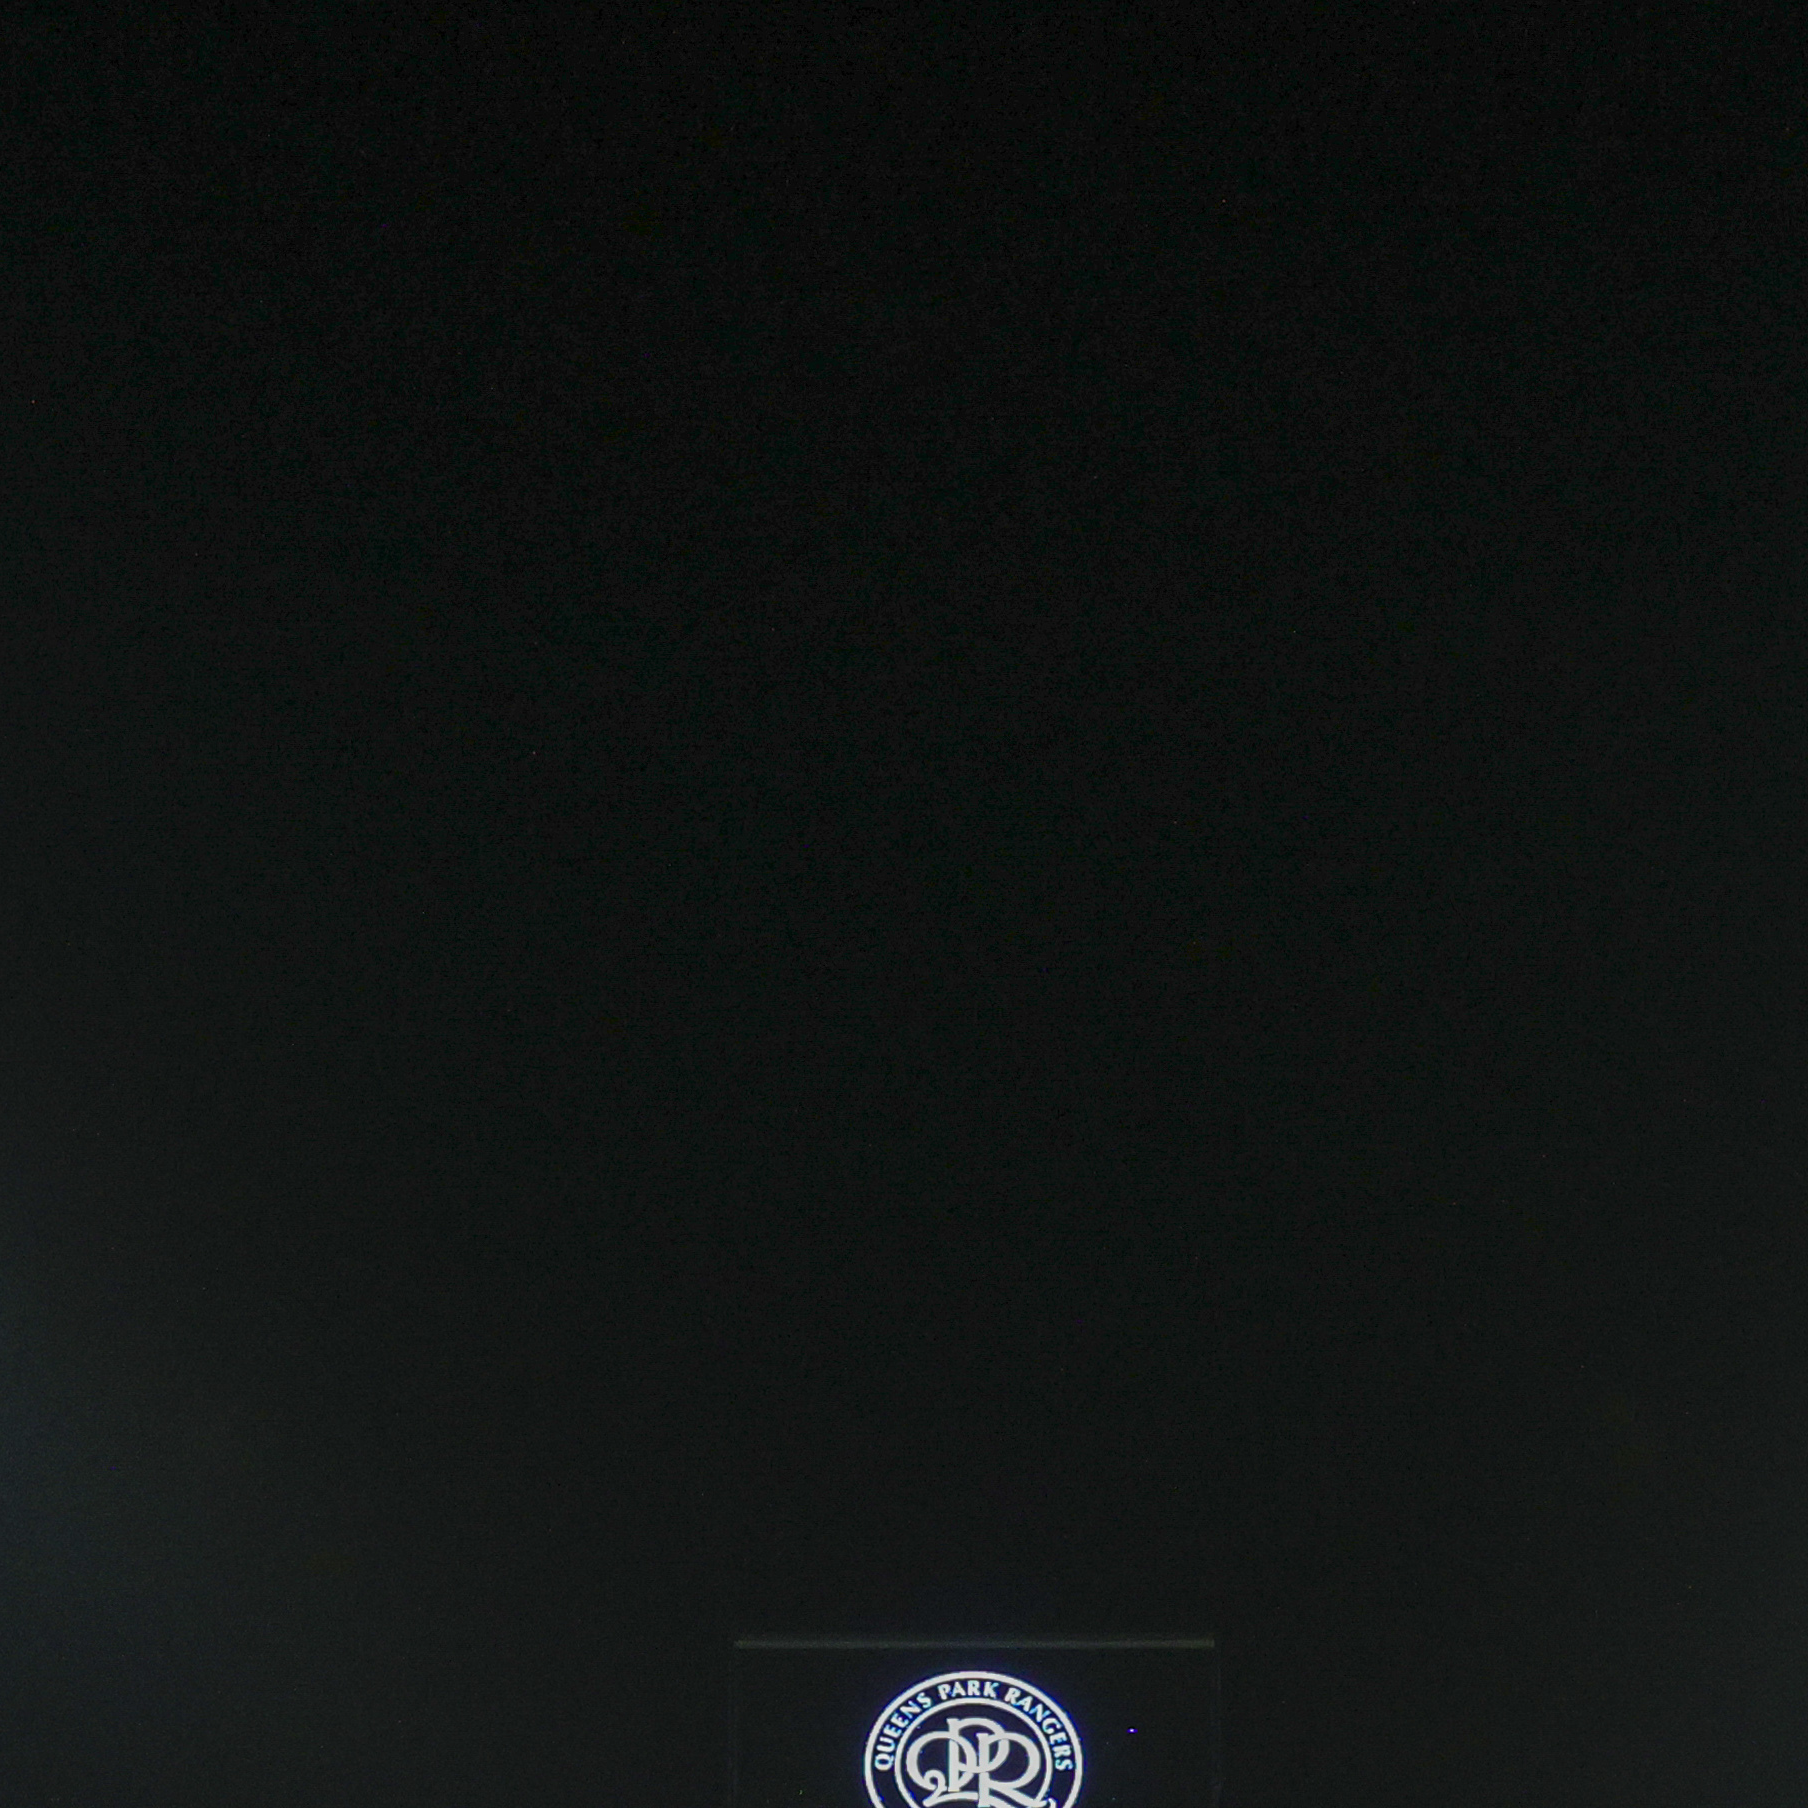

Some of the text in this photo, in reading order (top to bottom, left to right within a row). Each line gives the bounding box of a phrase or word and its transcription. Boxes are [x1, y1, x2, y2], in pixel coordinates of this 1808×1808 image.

[874, 1679, 1074, 1772] QUEENS PARK RANGERS
